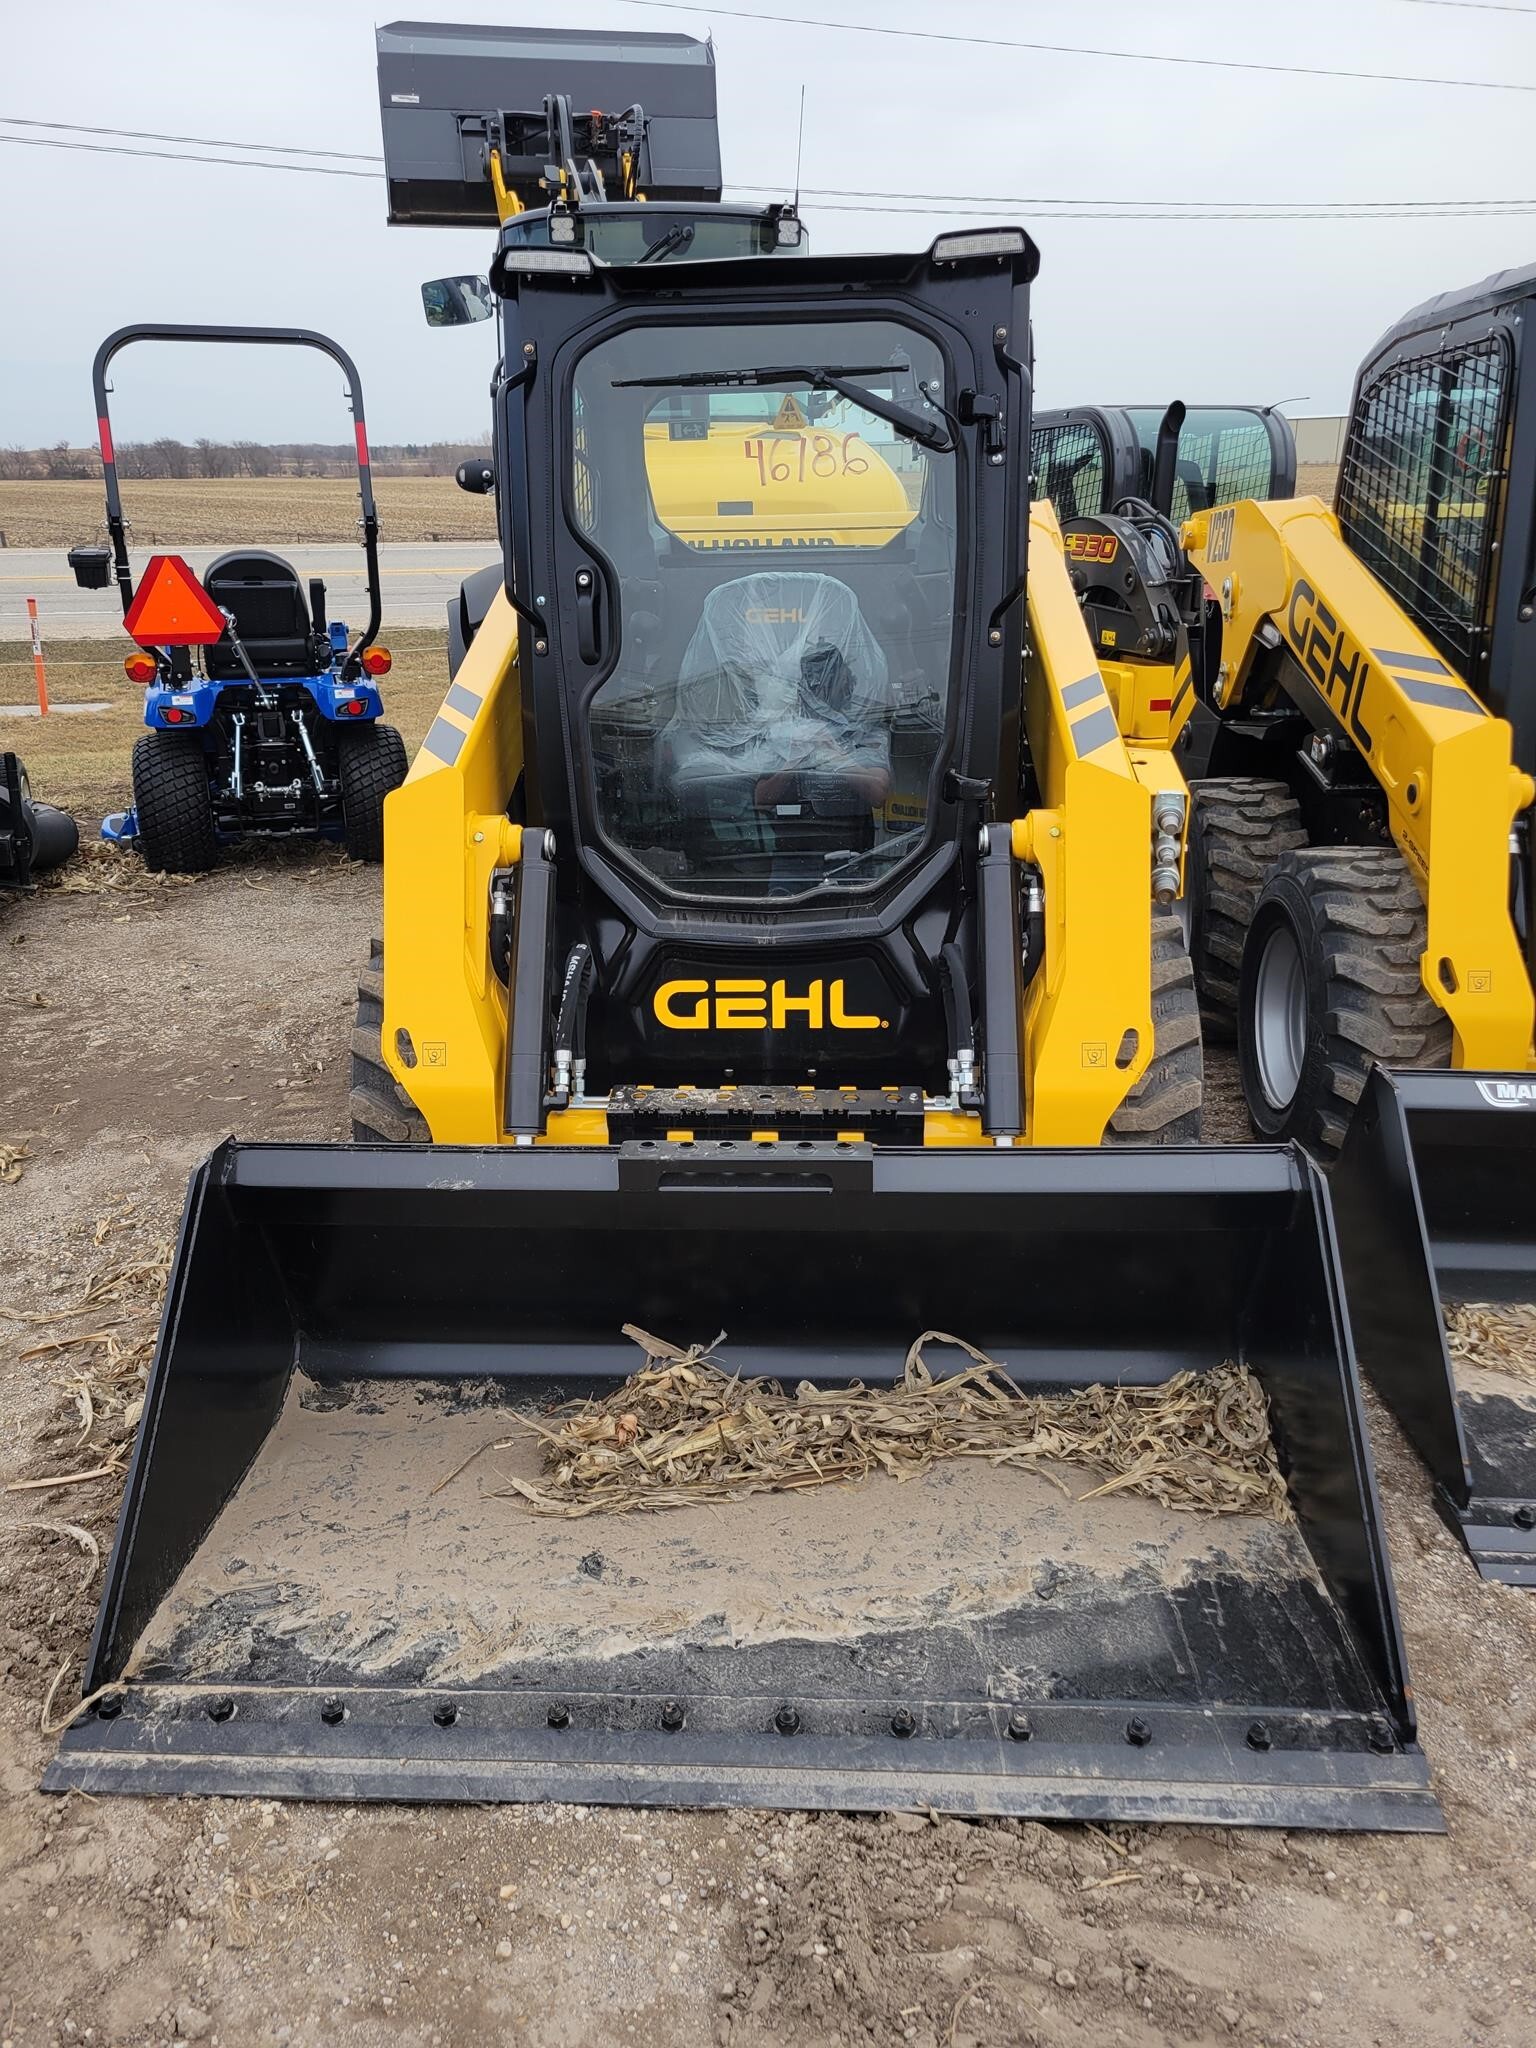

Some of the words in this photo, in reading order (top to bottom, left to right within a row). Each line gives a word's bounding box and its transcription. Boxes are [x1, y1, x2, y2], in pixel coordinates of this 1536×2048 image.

[1206, 508, 1235, 563] V230
[745, 607, 807, 624] GEHL
[1287, 578, 1373, 754] GEHL
[653, 979, 881, 1029] GEHL
